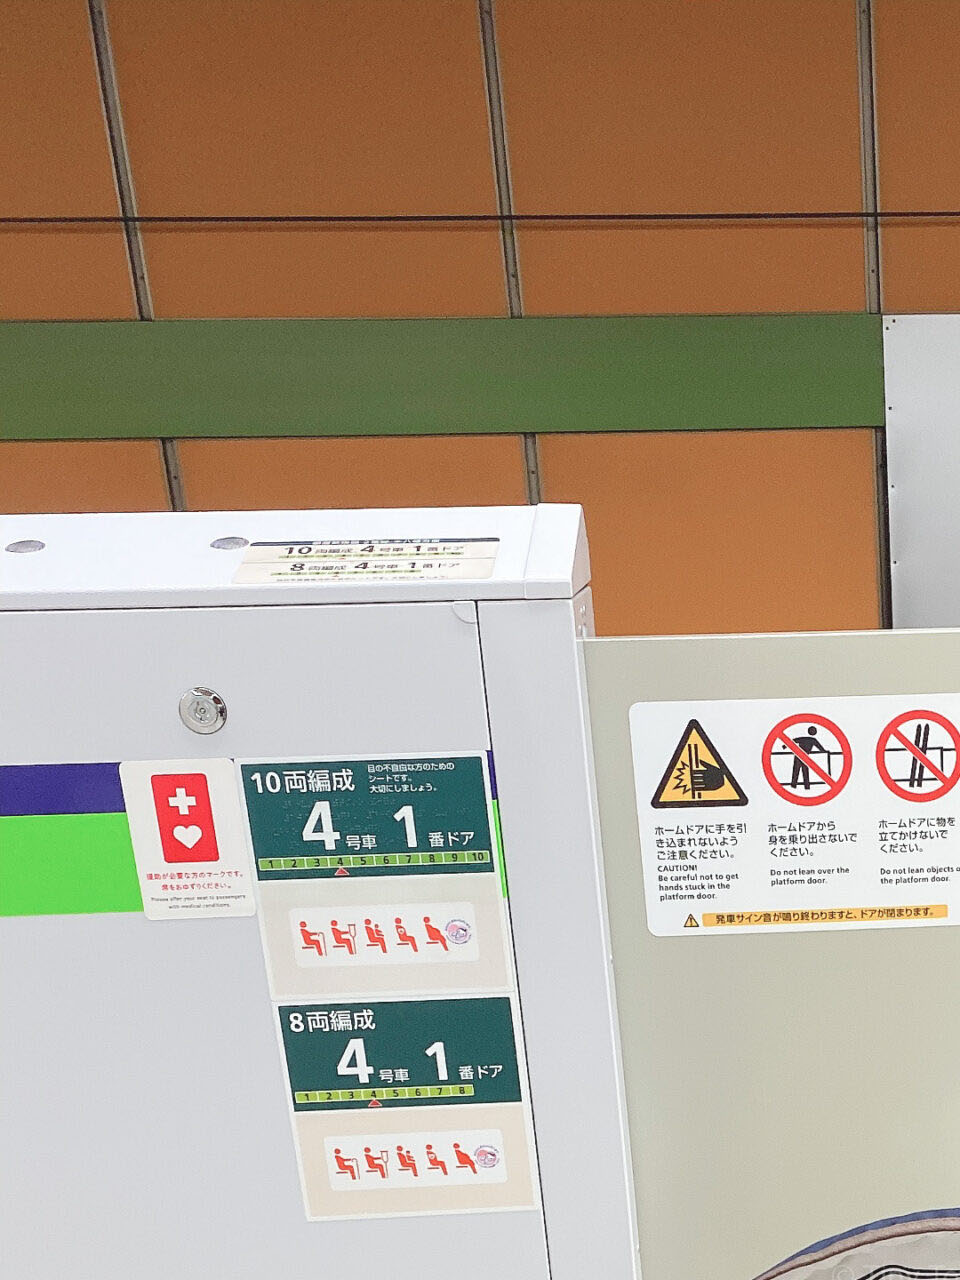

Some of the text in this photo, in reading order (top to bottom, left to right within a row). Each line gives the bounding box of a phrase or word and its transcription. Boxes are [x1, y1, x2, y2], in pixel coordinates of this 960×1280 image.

[360, 545, 375, 553] 4
[354, 562, 369, 570] 4
[367, 762, 455, 773] 目の不自由な方のための
[250, 769, 356, 794] 10両編成
[369, 774, 413, 783] シートです。
[369, 783, 438, 794] 大切にしましょう。
[302, 800, 475, 851] 4 号車 1 番ドア
[767, 820, 836, 833] ホームドアから
[878, 816, 956, 829] ホームドアに物を
[654, 822, 747, 836] ホームドアに手を引
[656, 835, 739, 848] き込まれないよう
[768, 832, 858, 846] 身を乗り出さないで
[878, 829, 949, 842] 立てかけないで
[770, 846, 815, 858] ください。
[880, 843, 924, 854] ください。
[268, 852, 485, 869] 1 2 3 4 5 6 7 8 9 10
[657, 849, 735, 861] ご注意ください。
[657, 864, 698, 873] CAUTION!
[783, 868, 797, 876] not
[798, 867, 816, 876] lean
[816, 867, 835, 875] over
[836, 866, 850, 874] the
[880, 867, 892, 876] Do
[892, 867, 907, 875] not
[907, 866, 925, 874] lean
[926, 865, 955, 875] objects
[658, 874, 668, 882] Be
[670, 873, 698, 882] careful
[699, 873, 713, 881] not
[725, 873, 740, 882] get
[770, 877, 806, 887] platform
[880, 877, 894, 885] the
[895, 875, 929, 886] platform
[658, 882, 731, 892] hands stuck in the
[659, 892, 695, 902] platform
[715, 907, 935, 924] 発車サイン音が鳴り終わりますと、ドアが閉まります。
[289, 1009, 376, 1033] 8両編成
[336, 1037, 503, 1084] 4 号車 1 番ドア
[304, 1086, 466, 1102] 1 2 3 4 5 6 7 8
